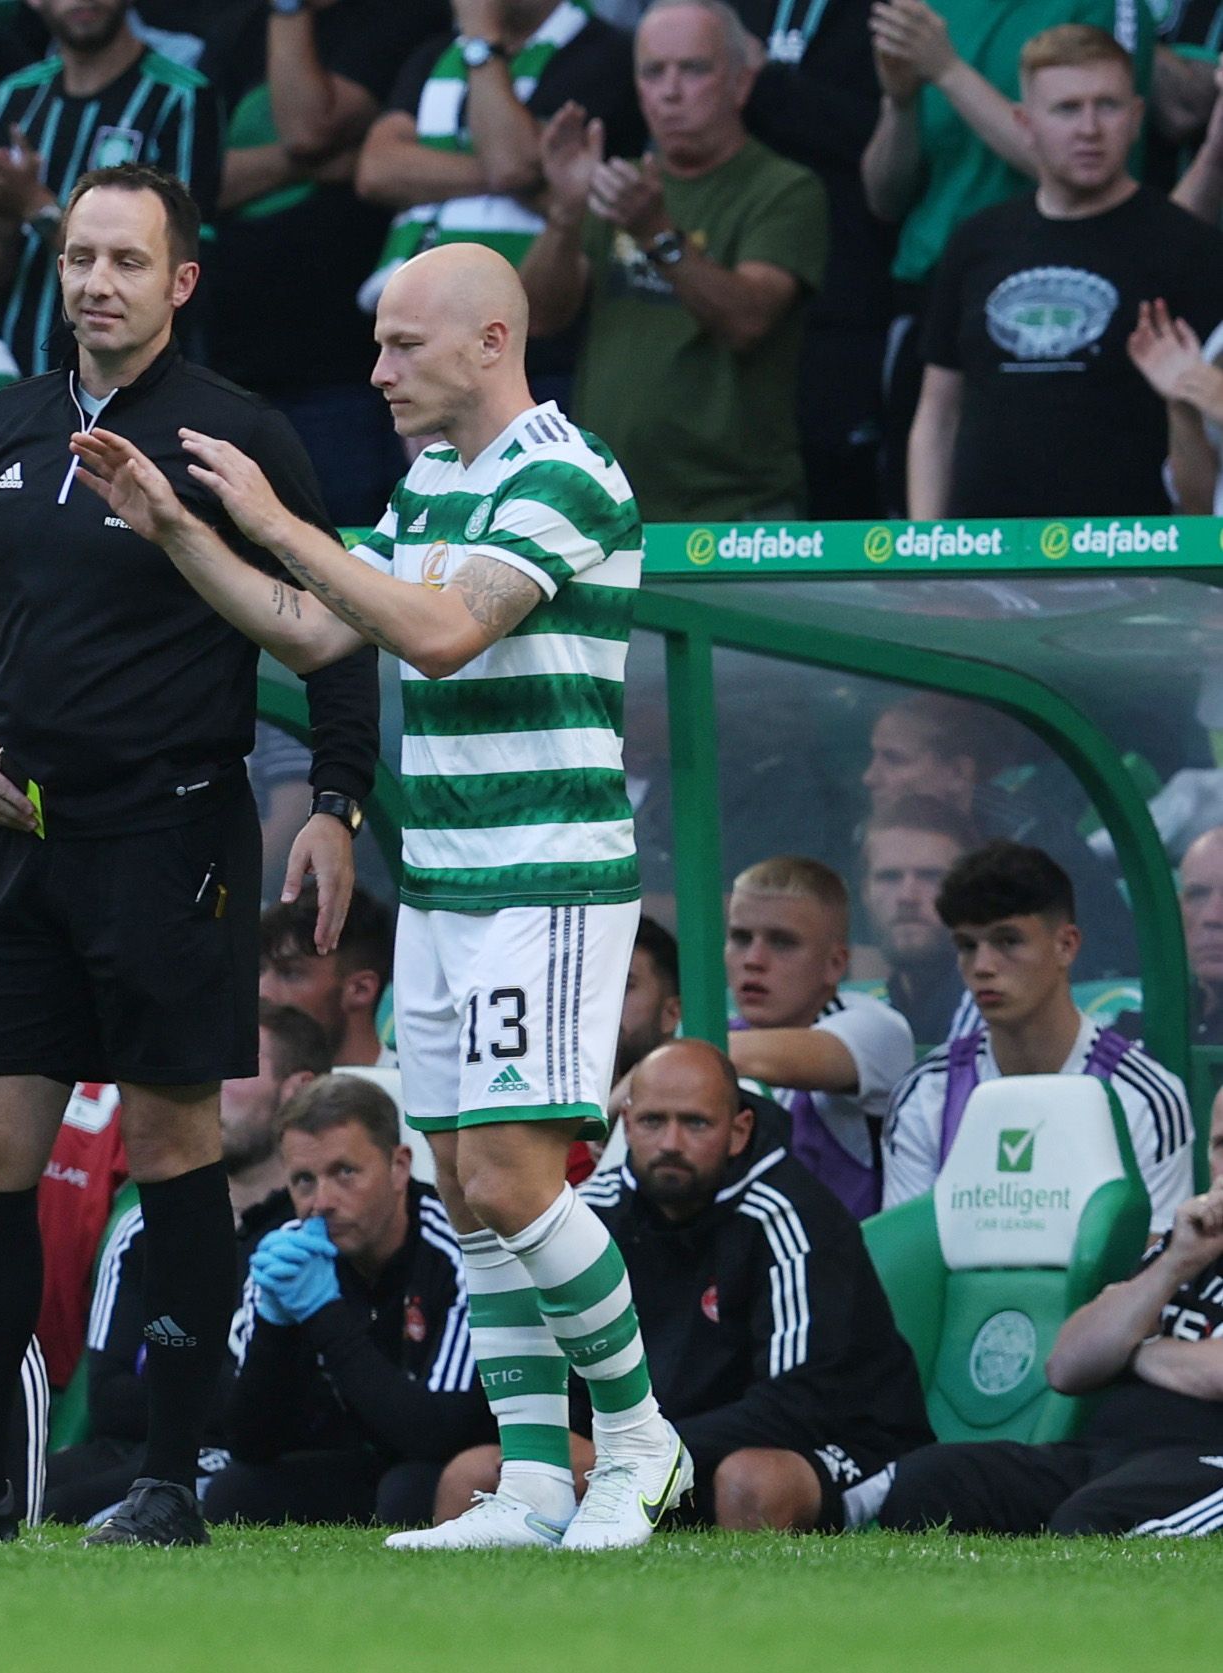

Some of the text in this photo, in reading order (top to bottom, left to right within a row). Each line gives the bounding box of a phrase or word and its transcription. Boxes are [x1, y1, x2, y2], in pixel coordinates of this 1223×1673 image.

[718, 528, 825, 563] dafabet
[895, 525, 1003, 561] dafabet
[1072, 522, 1179, 557] dafabet
[465, 984, 529, 1065] 13
[951, 1181, 1070, 1215] intelligent
[480, 1368, 524, 1388] LTIC
